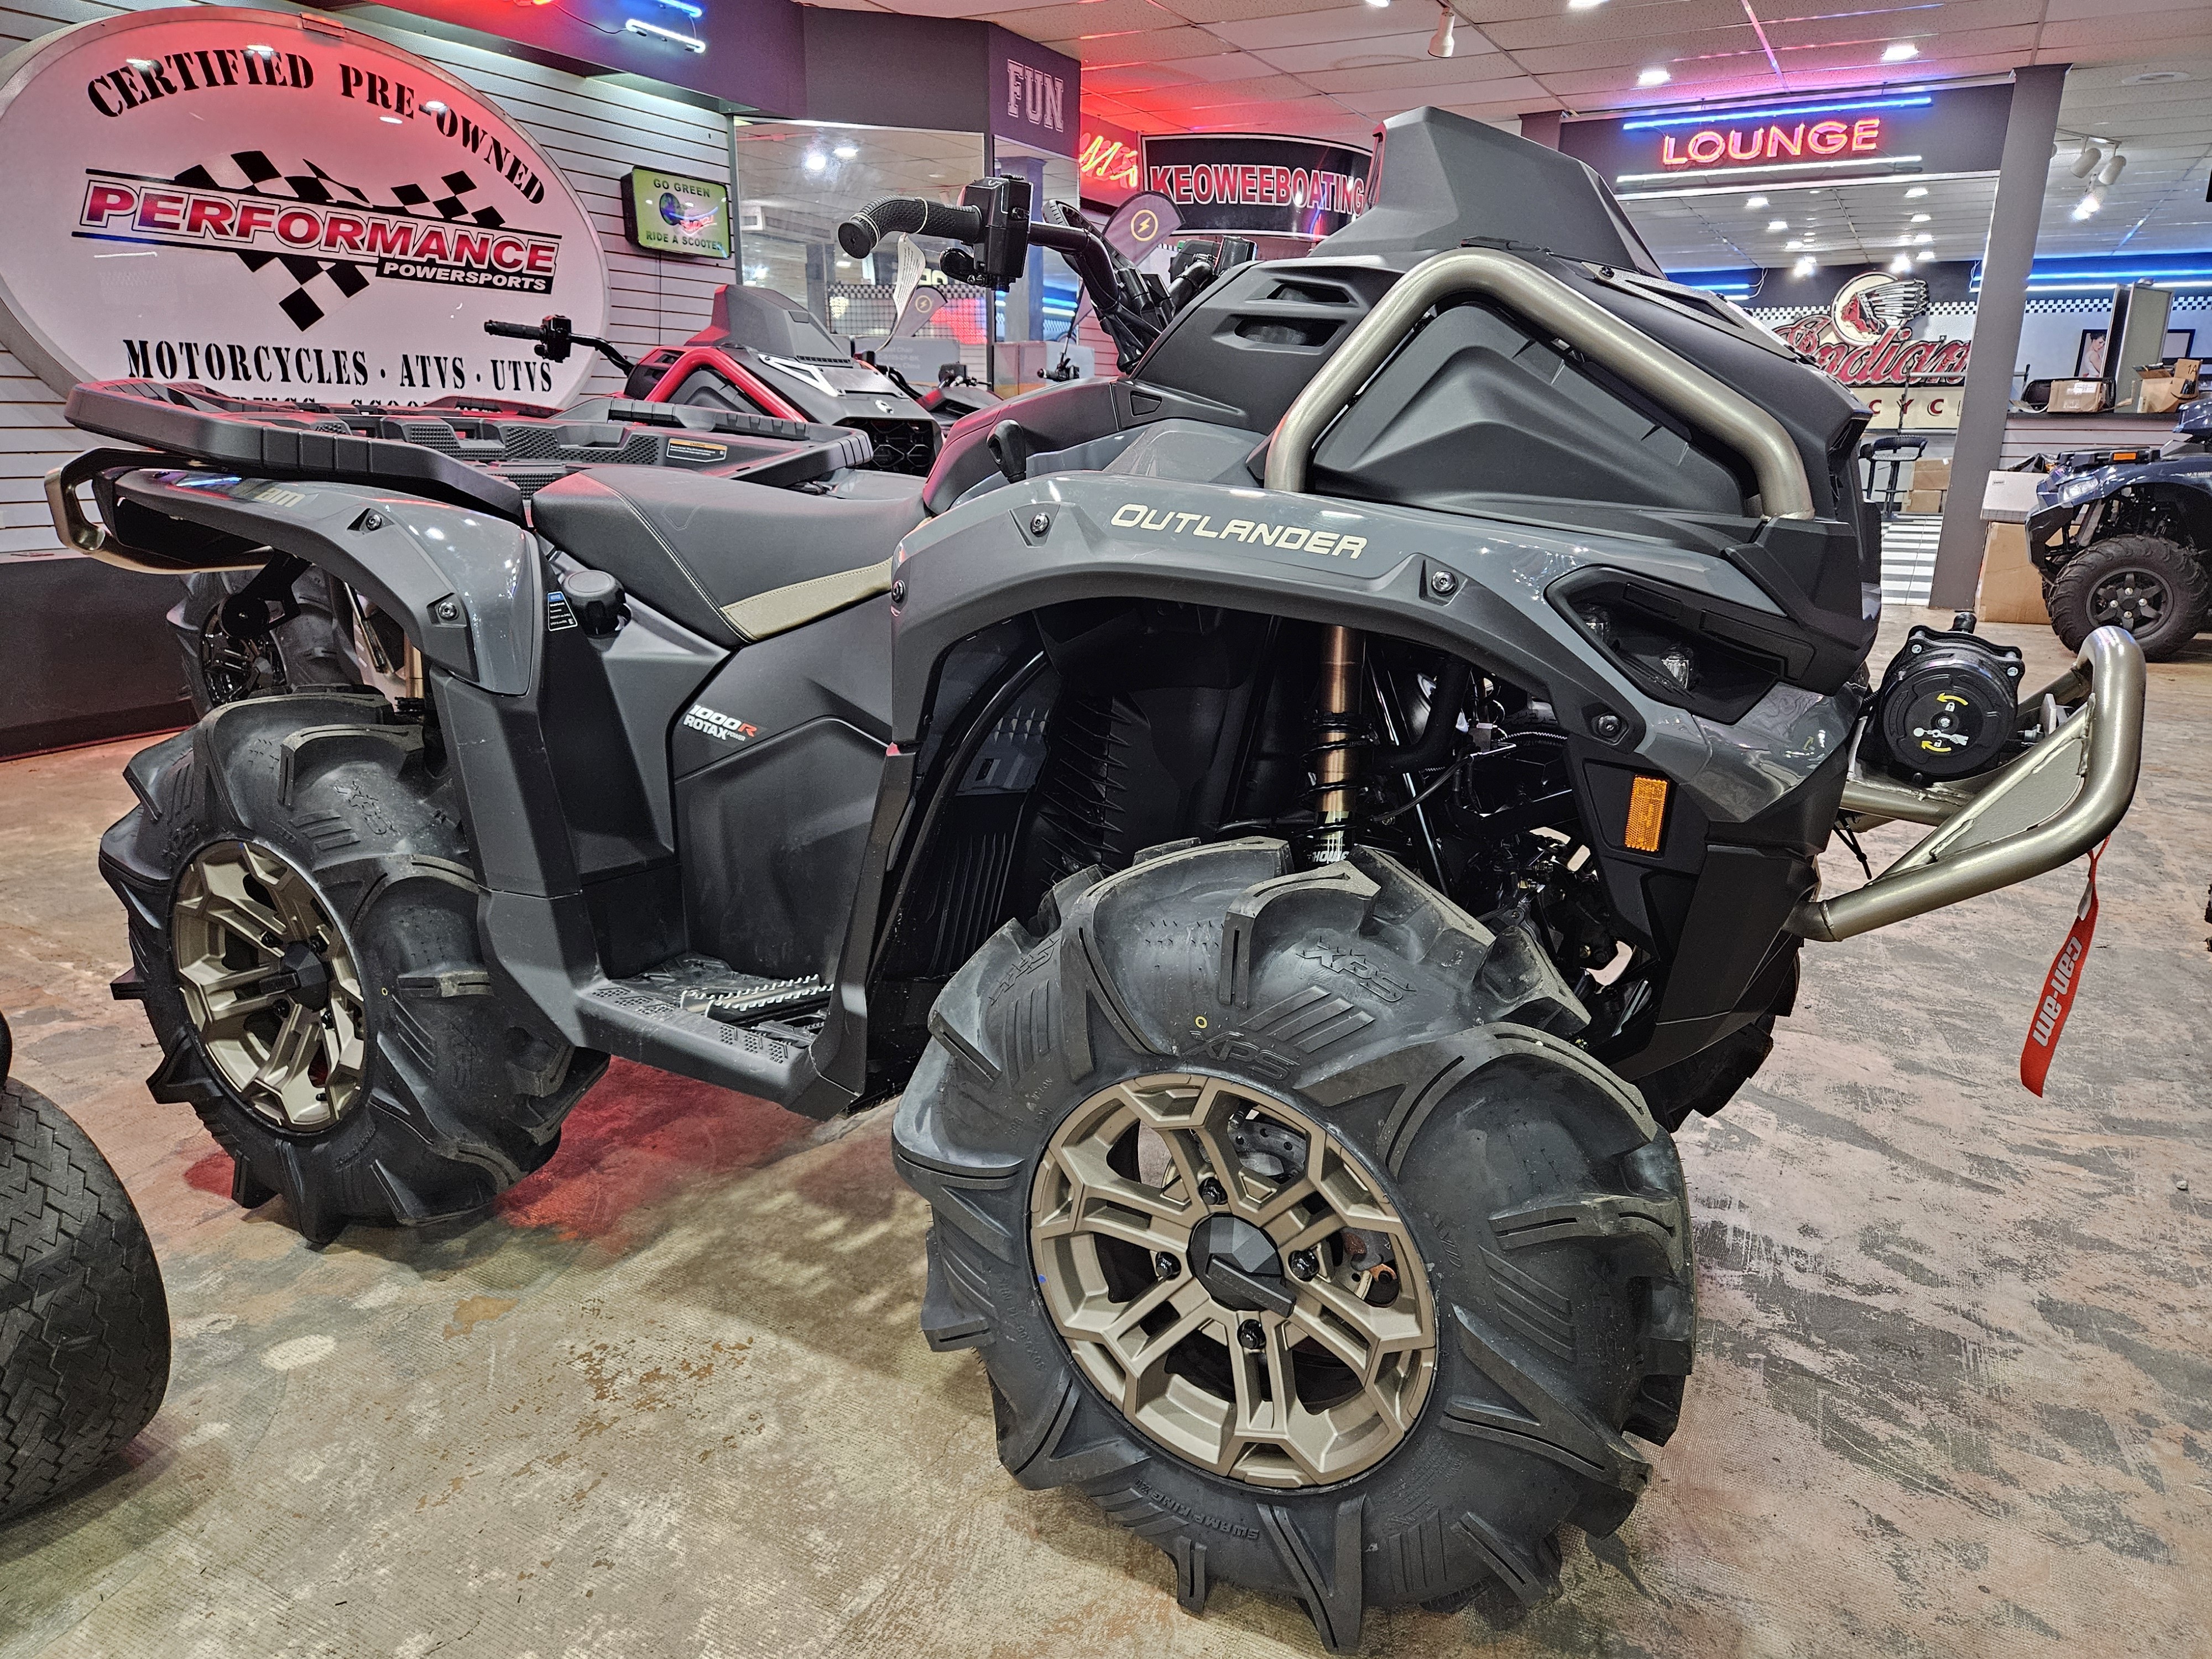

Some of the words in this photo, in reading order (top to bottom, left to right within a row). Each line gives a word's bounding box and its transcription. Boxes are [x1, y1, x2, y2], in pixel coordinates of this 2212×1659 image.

[1008, 59, 1063, 132] FUN
[87, 49, 314, 117] CERTIFIED
[340, 64, 545, 205] PRE-OWNED
[1663, 118, 1880, 164] LOUNGE
[653, 178, 670, 190] GO
[674, 182, 711, 197] GREEN
[1150, 164, 1364, 217] KEOWEEBOATING
[80, 180, 559, 275] PERFORMANCE
[646, 231, 669, 242] RIDE
[383, 262, 546, 291] POWERSPORTS
[123, 338, 369, 387] MOTORCYCLES
[399, 354, 466, 389] ATVS
[491, 359, 552, 393] UTVS
[1111, 504, 1368, 560] OUTLANDER
[684, 714, 726, 740] ROTAX
[727, 731, 745, 741] POWER
[689, 705, 757, 737] 1000R
[1296, 940, 1417, 1003] XPS
[2032, 936, 2083, 1047] can-am
[1181, 1030, 1300, 1082] XPS
[1193, 1513, 1260, 1540] SWAMP
